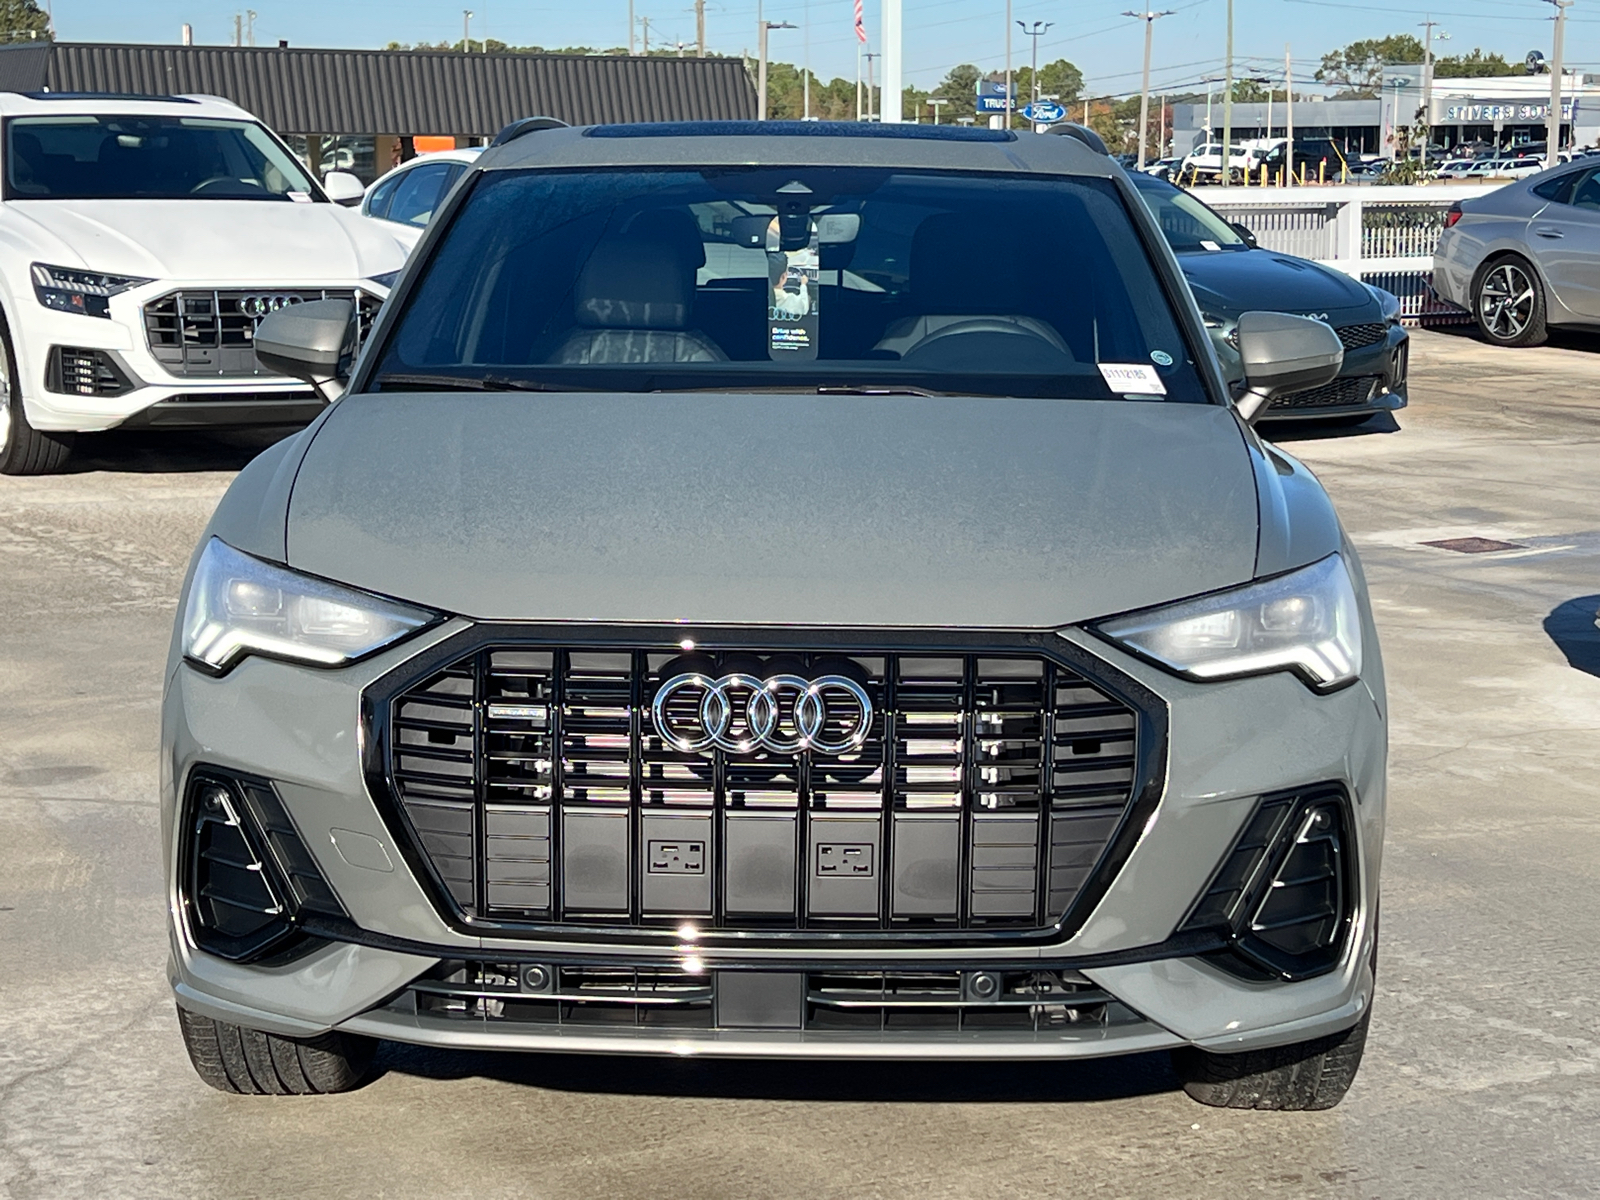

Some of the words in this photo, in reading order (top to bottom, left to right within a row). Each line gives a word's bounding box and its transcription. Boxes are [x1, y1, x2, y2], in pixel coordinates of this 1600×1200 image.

[983, 98, 1016, 109] TRUCS
[1033, 104, 1059, 120] Ford
[1447, 104, 1513, 121] STIVERS
[1519, 104, 1572, 121] SOUH
